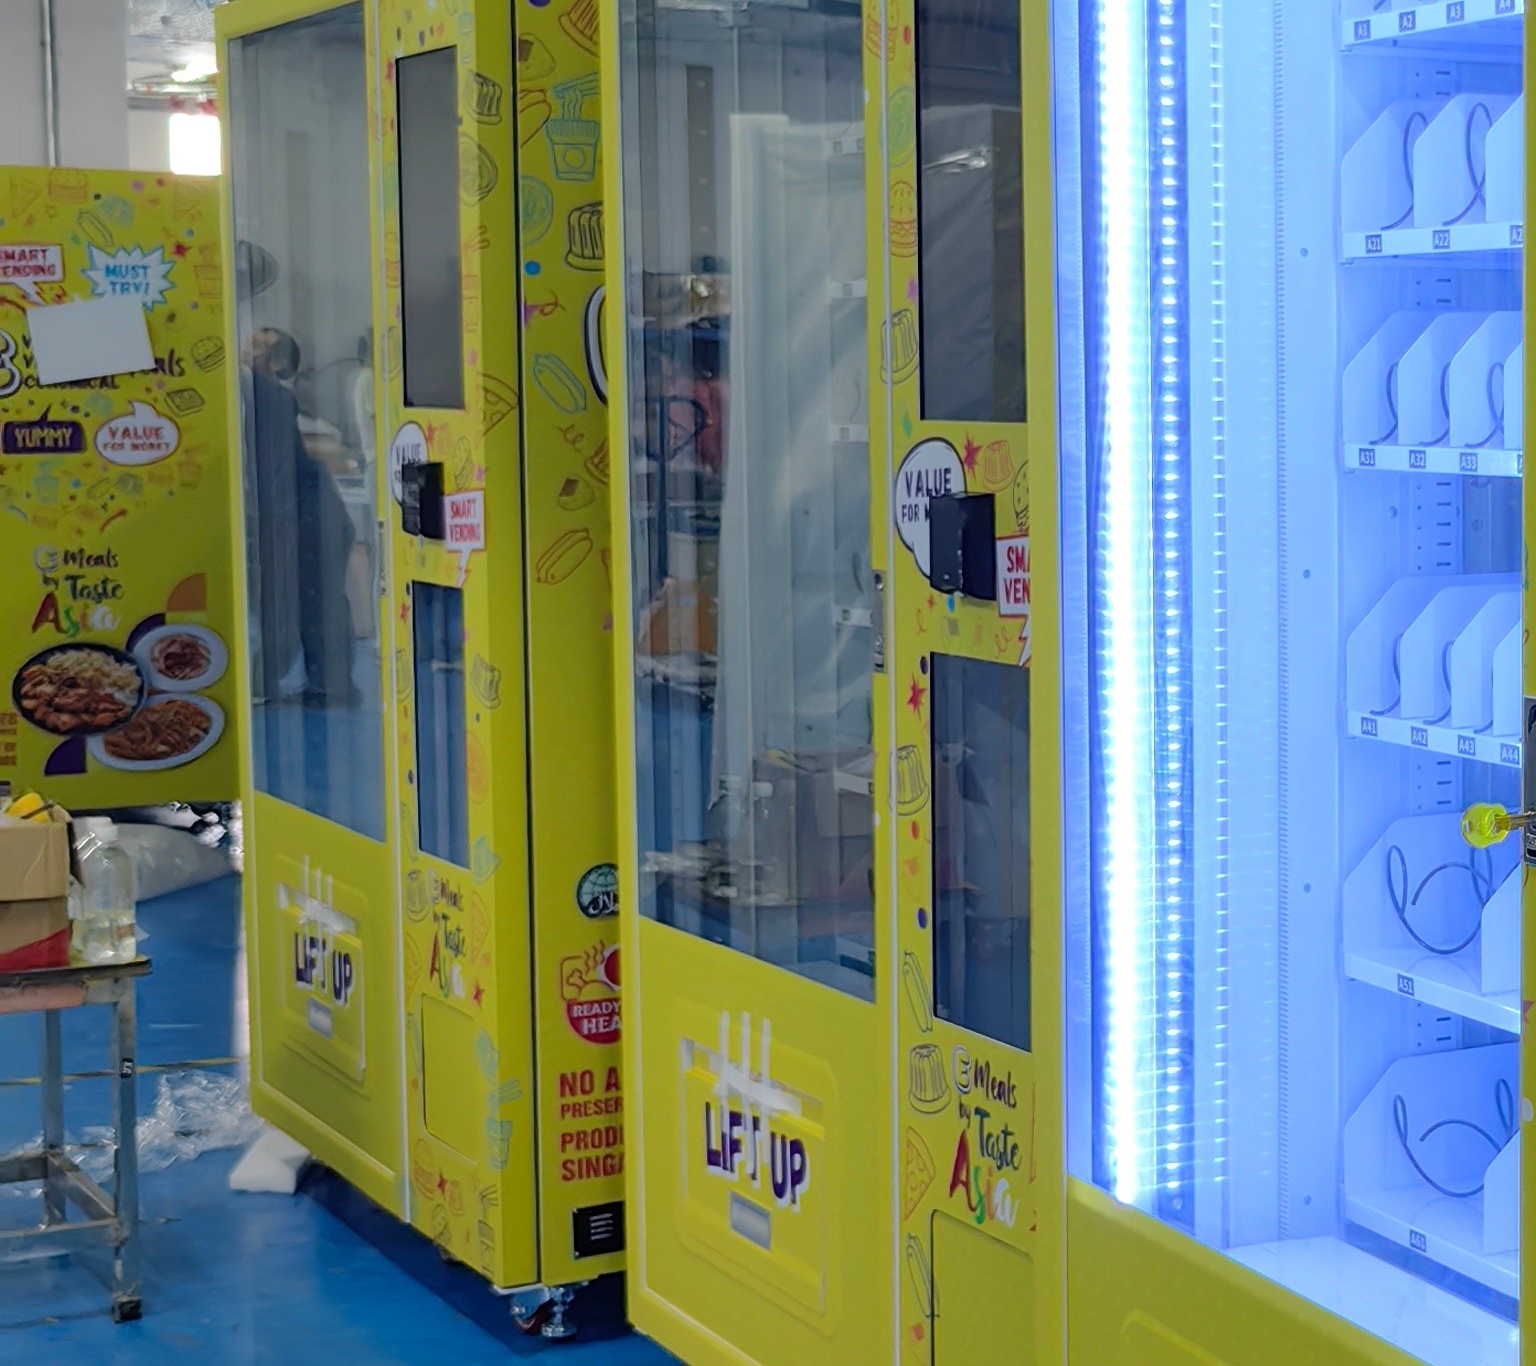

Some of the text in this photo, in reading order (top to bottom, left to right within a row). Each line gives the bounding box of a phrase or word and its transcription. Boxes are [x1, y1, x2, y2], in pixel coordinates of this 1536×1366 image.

[0, 263, 56, 278] ENDING
[105, 265, 151, 279] MUST
[110, 281, 150, 295] TRY!
[14, 426, 73, 448] YUMMY
[109, 426, 164, 441] VALUE
[905, 467, 952, 499] VALUE
[450, 499, 477, 520] SMART
[901, 505, 920, 522] FOR
[449, 523, 481, 544] VENDING
[332, 949, 353, 1002] UP
[582, 1016, 622, 1036] HEA
[560, 1069, 595, 1098] NO
[561, 1097, 623, 1121] PRESER
[974, 1107, 1022, 1171] Taste
[771, 1132, 807, 1204] UP
[949, 1129, 1019, 1228] Asia
